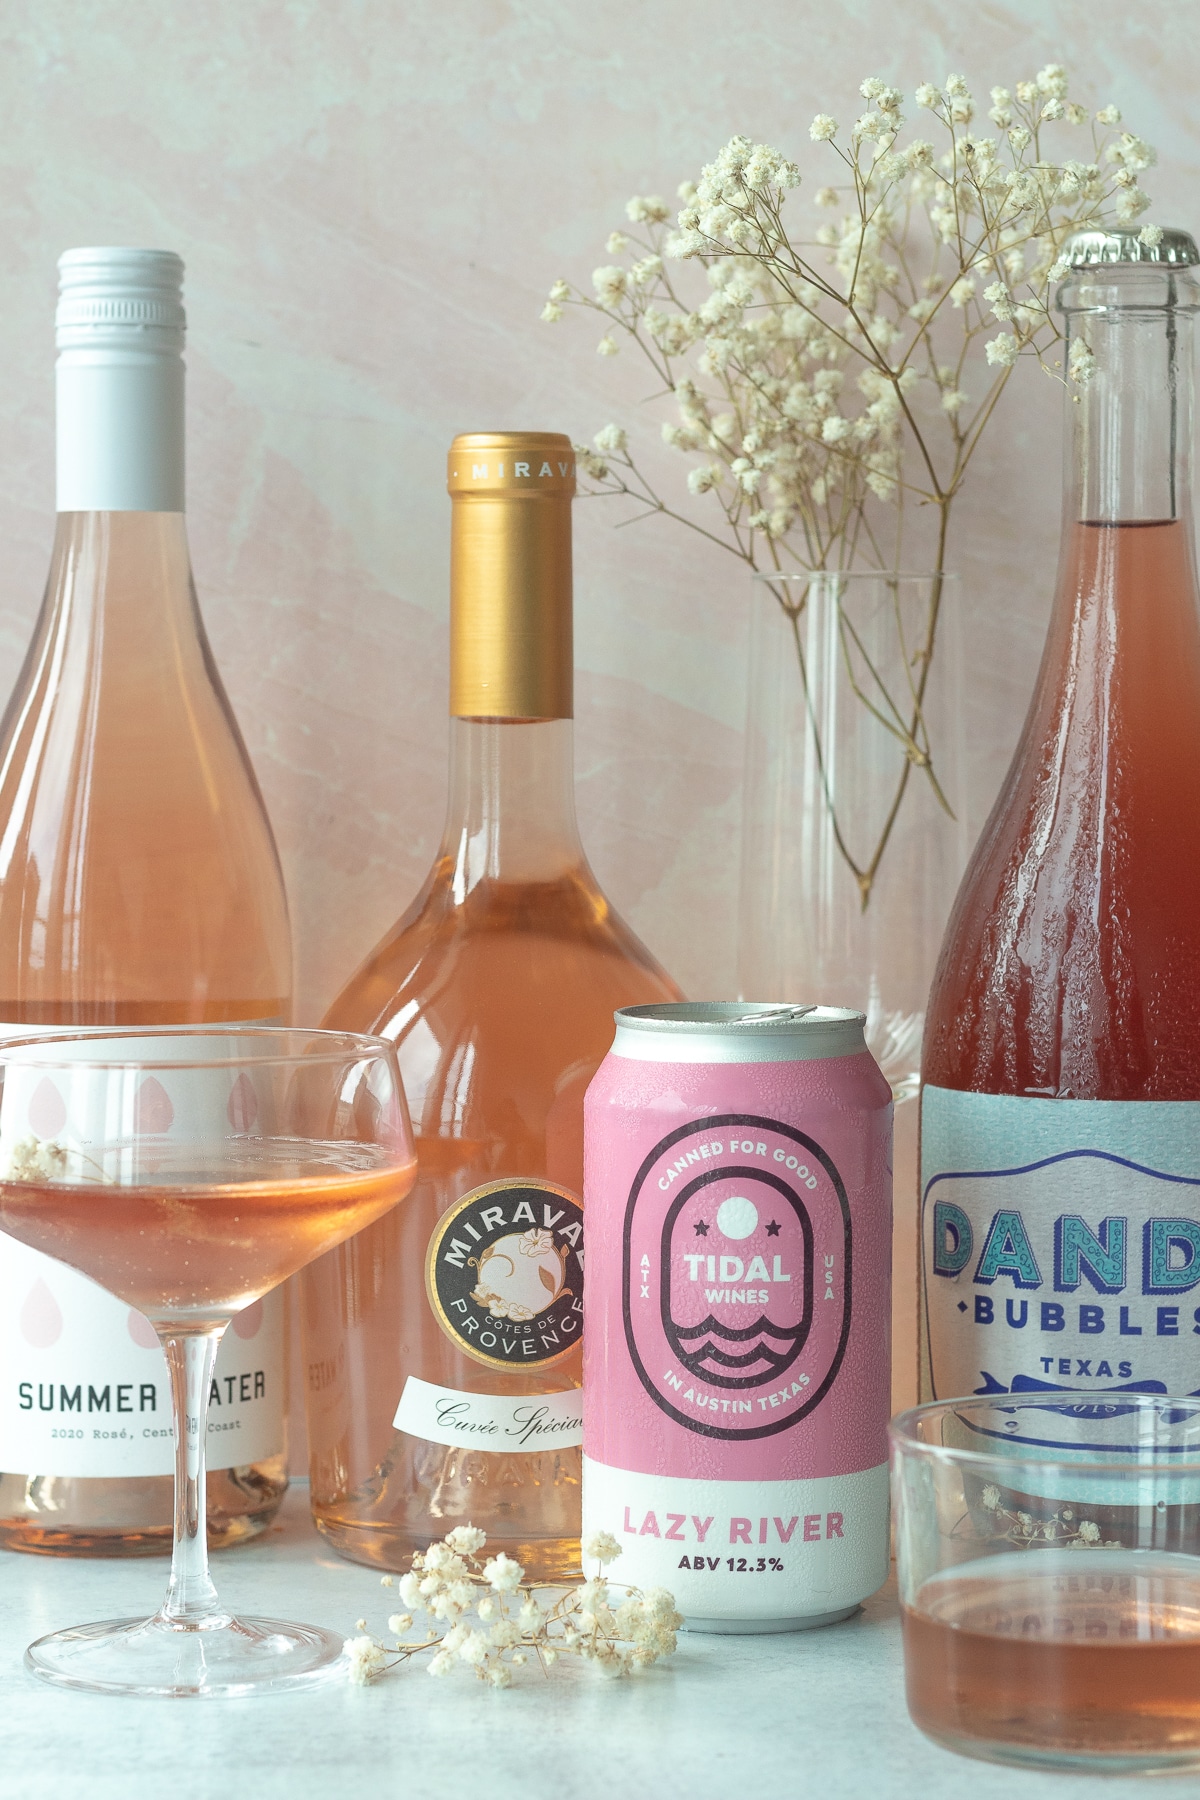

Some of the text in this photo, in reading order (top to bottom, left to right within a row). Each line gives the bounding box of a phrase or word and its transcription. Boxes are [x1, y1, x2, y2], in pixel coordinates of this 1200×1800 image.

[658, 1140, 818, 1191] CANNED FOR GOOD
[639, 1253, 650, 1299] ATX
[683, 1254, 791, 1283] TIDAL
[824, 1255, 835, 1300] USA
[704, 1289, 770, 1304] WINES
[484, 1314, 556, 1334] CÔTES DE
[1040, 1356, 1133, 1378] TEXAS
[19, 1370, 266, 1413] SUMMER ATER
[663, 1369, 811, 1413] IN AUSTIN TEXAS
[51, 1428, 84, 1439] 2020
[93, 1427, 135, 1441] Rosé,
[208, 1419, 242, 1433] Coast
[435, 1398, 499, 1436] Cuvée
[624, 1506, 845, 1545] LAZY RIVER
[678, 1555, 785, 1572] ABV 12.3%
